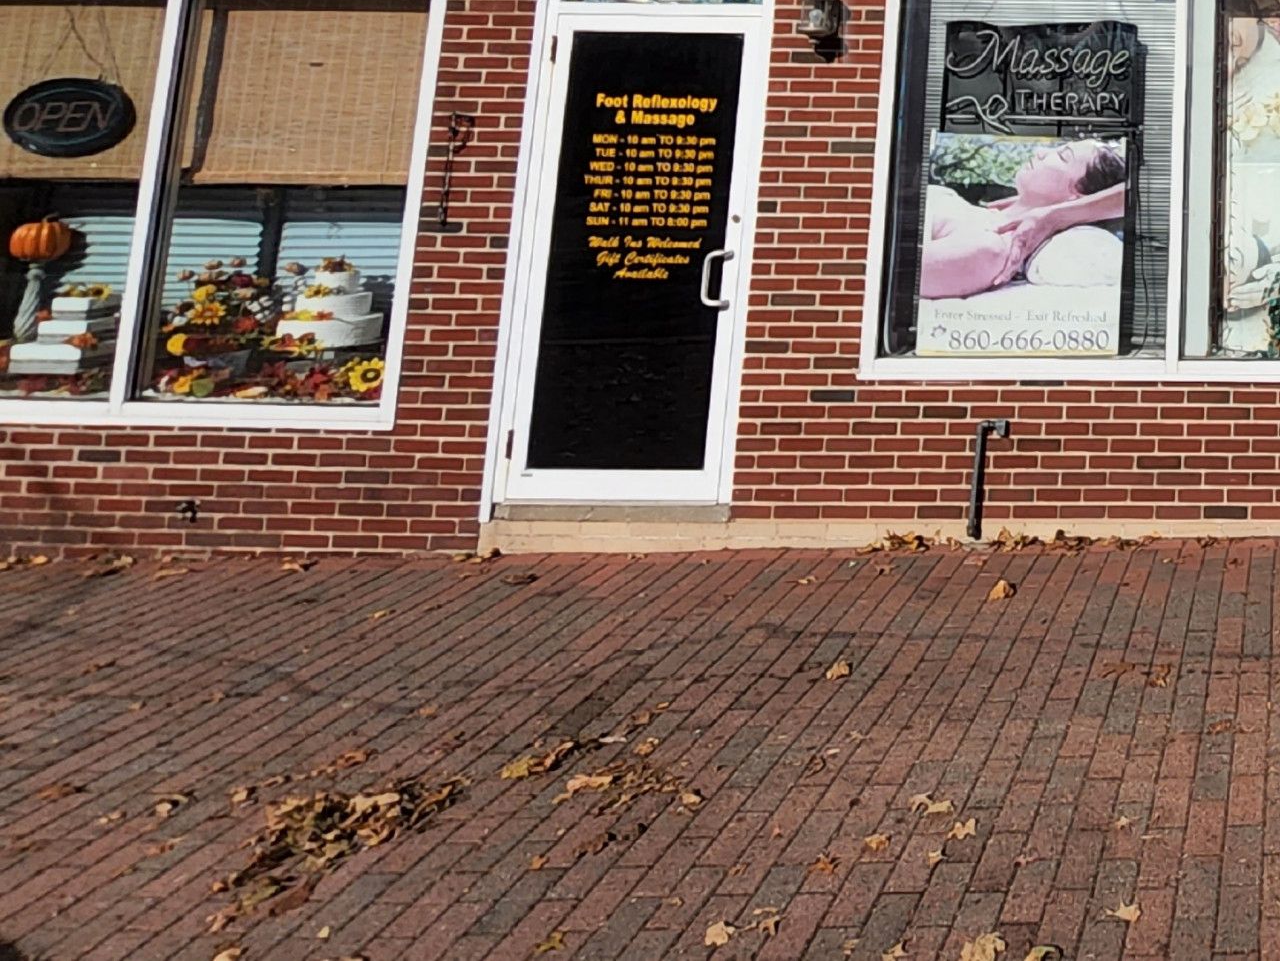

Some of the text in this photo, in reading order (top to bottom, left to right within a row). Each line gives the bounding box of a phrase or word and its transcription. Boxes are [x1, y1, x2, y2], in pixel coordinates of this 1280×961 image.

[946, 30, 1130, 88] Massage
[596, 92, 718, 113] Foot Reflexology
[1015, 89, 1125, 111] THERAPY
[12, 100, 118, 133] OPEN
[615, 109, 696, 129] & Massage
[592, 134, 618, 144] MON
[627, 135, 639, 145] 10
[641, 137, 656, 145] am
[659, 135, 674, 145] TO
[699, 138, 716, 147] pm
[595, 148, 616, 157] TUE
[625, 149, 638, 158] 10
[639, 150, 655, 159] am
[658, 149, 672, 159] TO
[698, 151, 714, 161] pm
[589, 161, 615, 172] WED
[624, 162, 636, 172] 10
[637, 164, 654, 172] am
[656, 162, 671, 172] TO
[696, 164, 713, 174] pm
[584, 174, 613, 185] THUR
[622, 176, 634, 185] 10
[636, 177, 652, 186] am
[654, 176, 670, 186] TO
[695, 178, 712, 188] pm
[593, 189, 612, 199] FRI
[621, 189, 633, 199] 10
[635, 191, 651, 200] am
[654, 189, 668, 200] TO
[693, 191, 711, 201] pm
[589, 202, 610, 212] SAT
[620, 203, 631, 213] 10
[632, 205, 649, 213] am
[652, 203, 667, 213] TO
[692, 205, 709, 215] pm
[586, 216, 609, 226] SUN
[619, 217, 629, 226] 11
[631, 218, 648, 226] am
[650, 217, 665, 226] TO
[690, 219, 707, 228] pm
[587, 235, 703, 249] Walk Ins Welcomed
[596, 250, 690, 267] Gift Certificates
[612, 267, 669, 279] Available
[934, 309, 963, 321] Enter
[966, 310, 1012, 322] Stressed
[1027, 310, 1049, 322] Exit
[1052, 311, 1107, 323] Refreshed
[948, 329, 1110, 351] 860-666-0880
